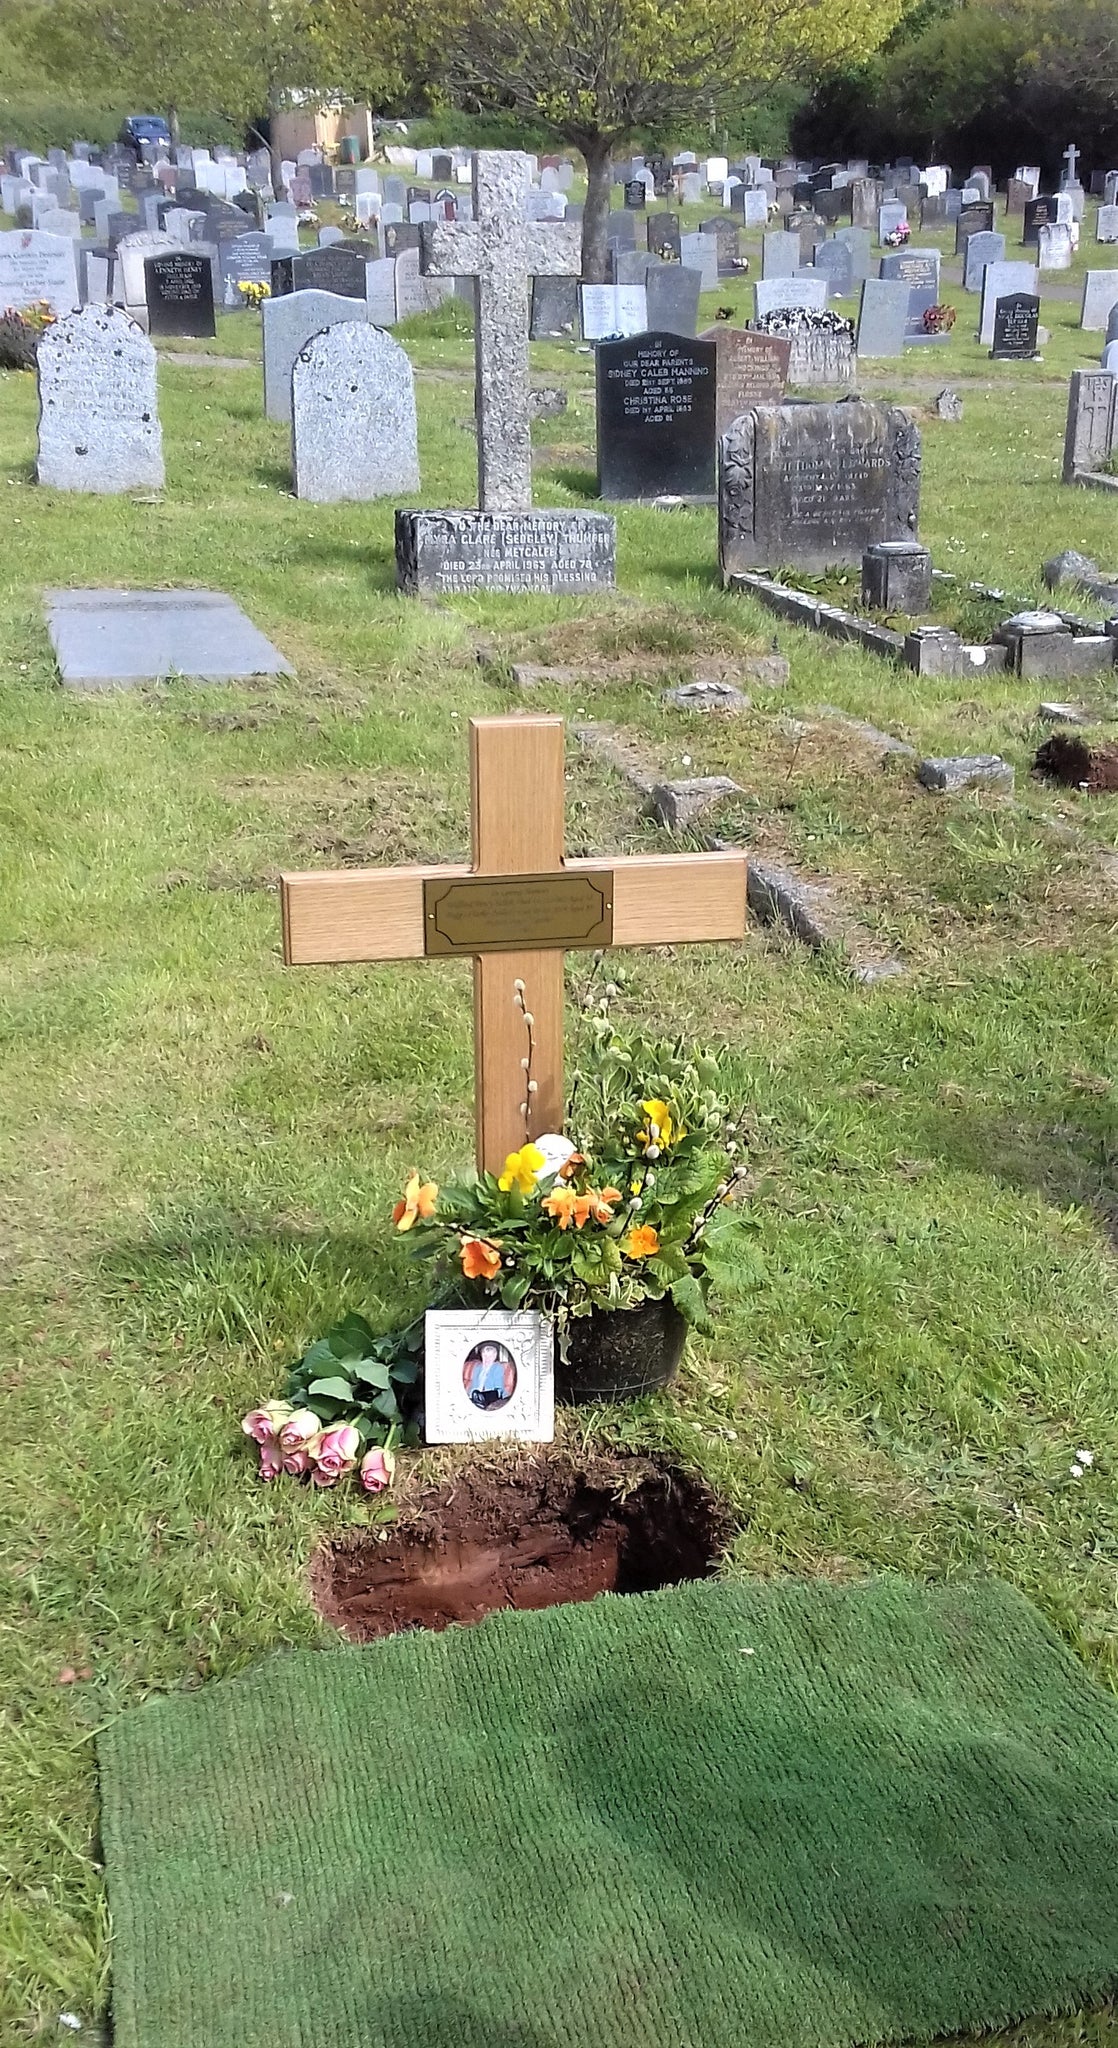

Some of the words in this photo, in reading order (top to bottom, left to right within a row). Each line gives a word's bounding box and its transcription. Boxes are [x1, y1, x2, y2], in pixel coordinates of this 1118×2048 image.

[637, 350, 667, 359] MEMORY
[669, 349, 679, 358] OF
[623, 360, 639, 368] OUR
[640, 359, 660, 368] DEAR
[661, 358, 694, 367] PARENTS
[607, 369, 638, 379] SIDNEY
[640, 368, 669, 378] CALEB
[671, 366, 709, 377] MANNING
[643, 387, 662, 396] AGED
[623, 396, 668, 406] CHRISTINA
[670, 395, 693, 404] ROSE
[493, 520, 519, 532] DEAR
[524, 520, 566, 532] MEMORY
[461, 533, 496, 545] CLARE
[504, 546, 556, 558] METCALFE
[443, 560, 466, 571] DIED
[493, 559, 521, 571] APRIL
[522, 559, 546, 570] 1963
[551, 559, 576, 570] AGED
[534, 571, 549, 582] HIS
